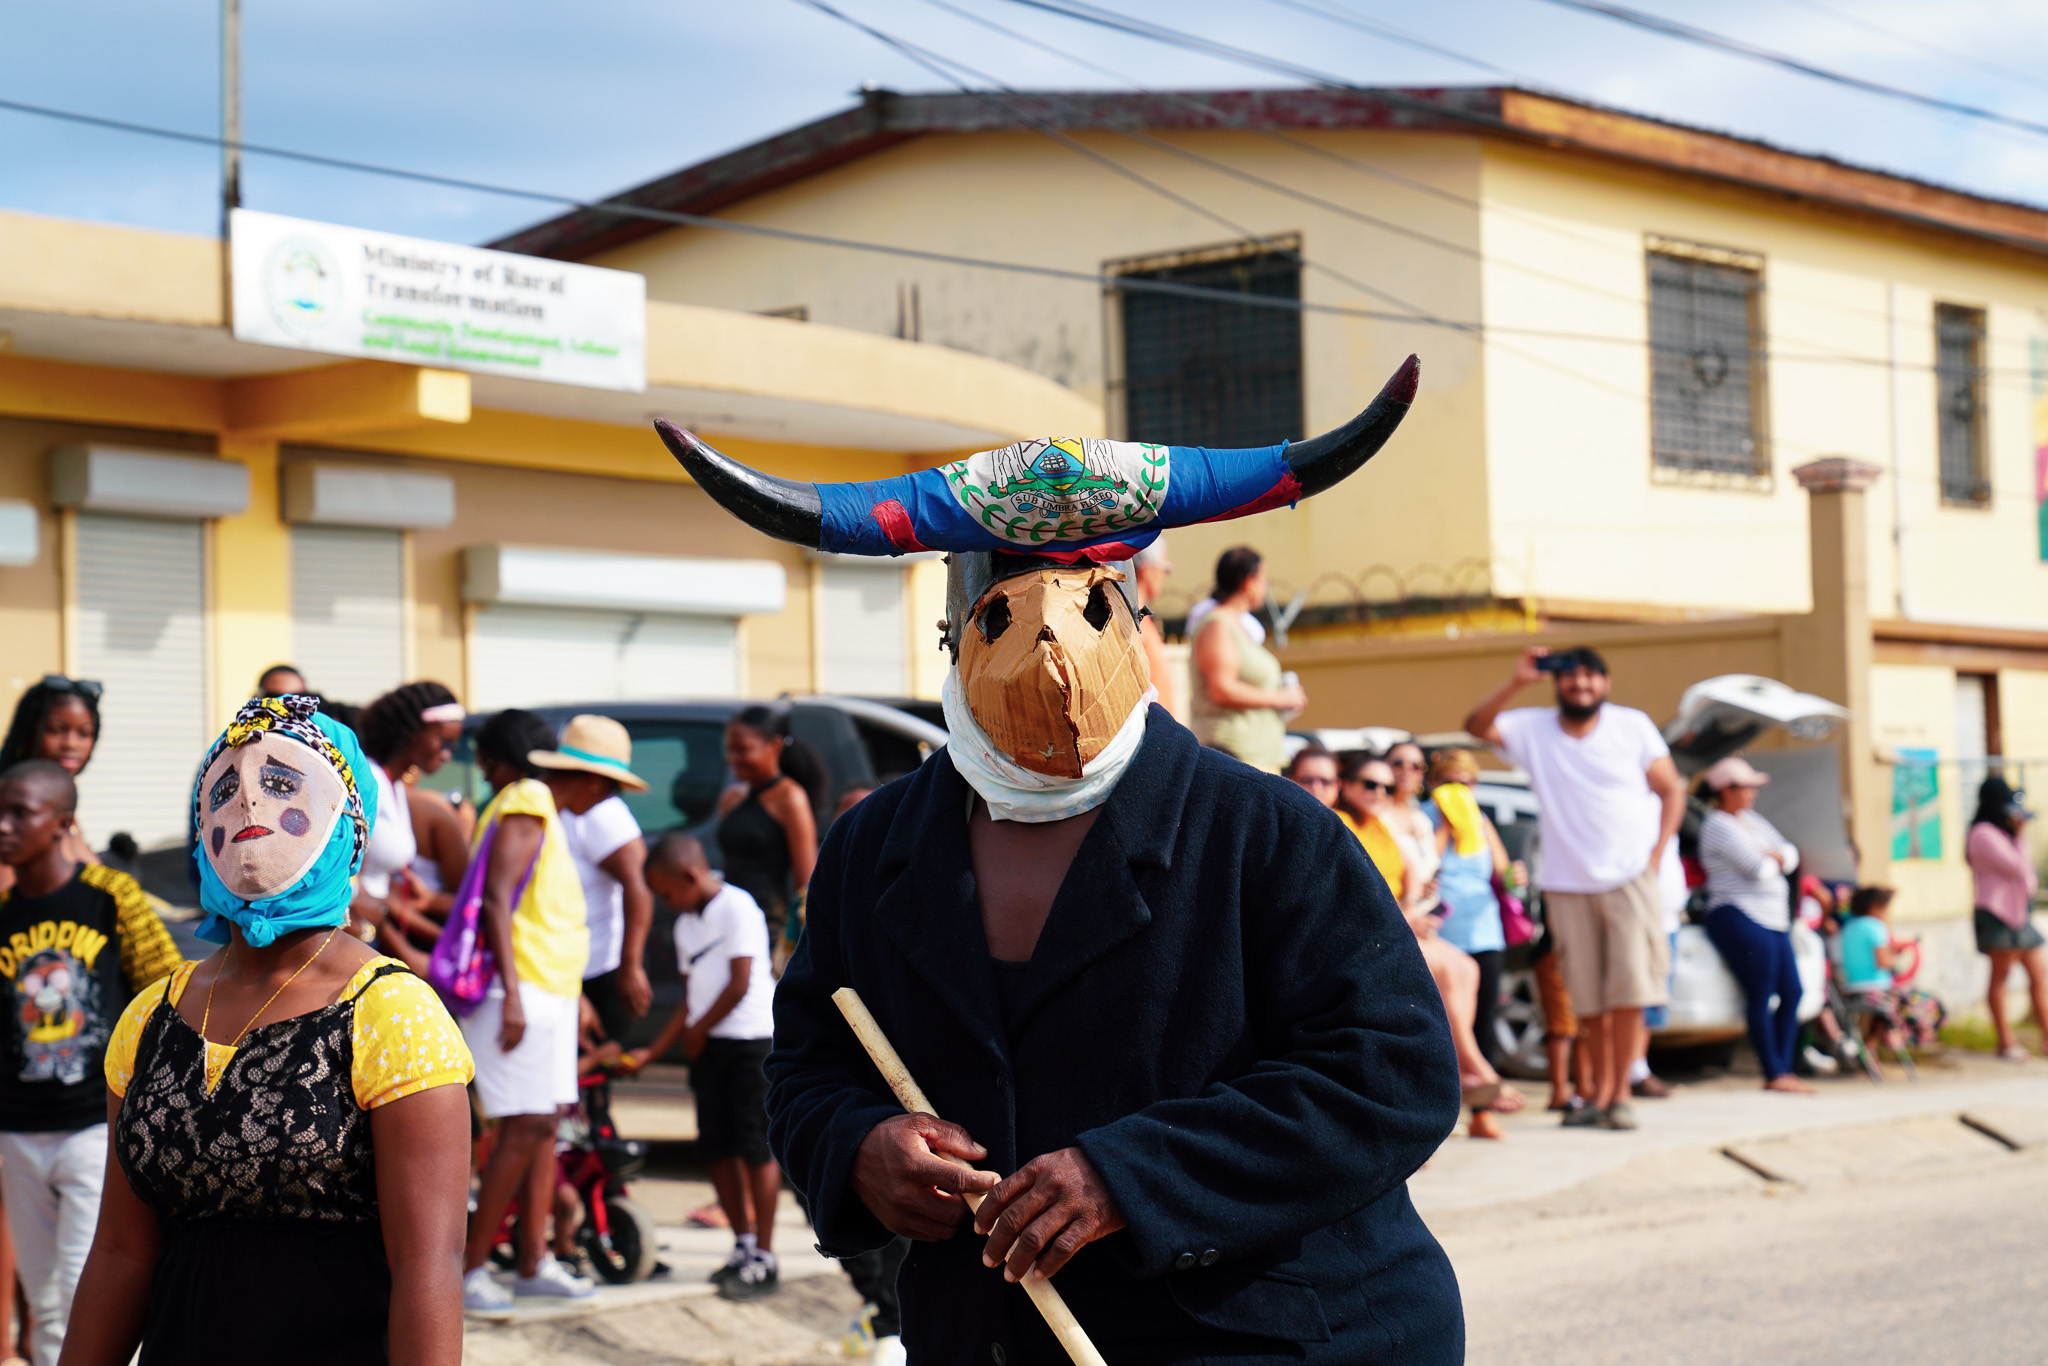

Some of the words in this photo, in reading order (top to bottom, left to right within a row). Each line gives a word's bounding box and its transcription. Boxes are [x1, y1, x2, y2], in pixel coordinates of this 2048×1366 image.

[363, 245, 461, 283] Ministry
[473, 263, 494, 284] of
[503, 265, 566, 294] Rural
[364, 273, 545, 320] Transformation
[1015, 494, 1038, 505] SUB
[1042, 500, 1078, 512] UMBRA
[1081, 491, 1113, 509] FLOREO
